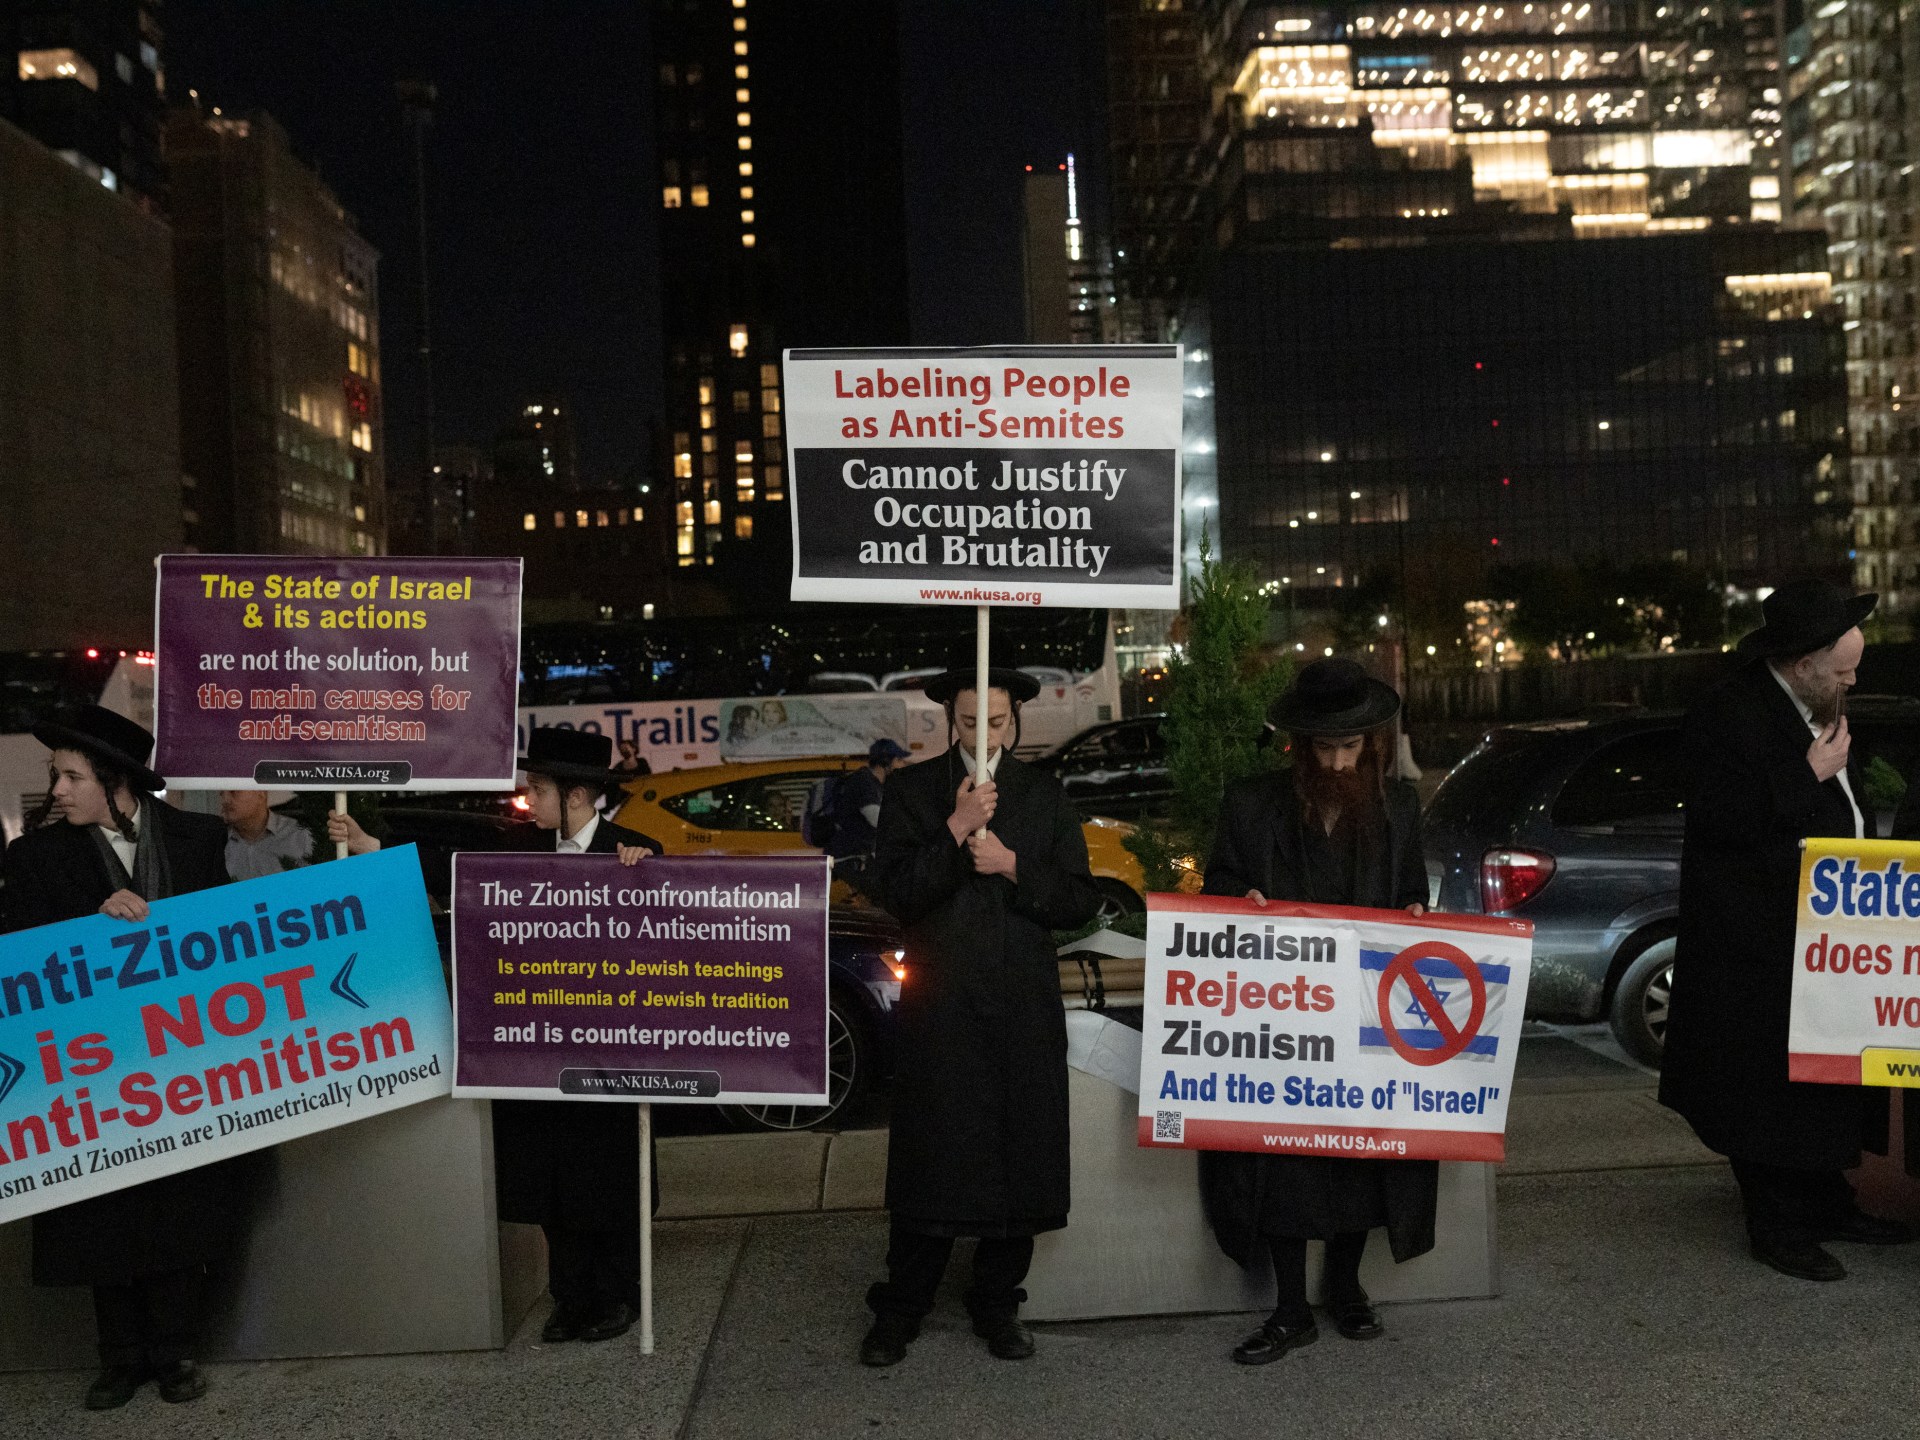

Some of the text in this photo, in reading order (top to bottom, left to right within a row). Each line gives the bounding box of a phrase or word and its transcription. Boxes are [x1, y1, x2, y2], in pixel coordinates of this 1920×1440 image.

[835, 367, 1130, 405] Labeling People
[841, 408, 1124, 439] as Anti-Semites
[842, 459, 1127, 500] Cannot Justify
[874, 497, 1092, 536] Occupation
[859, 534, 1111, 577] and Brutality
[201, 575, 471, 600] The State of Israel
[920, 587, 1041, 605] www.nkusa.org
[243, 603, 427, 629] & its actions
[200, 647, 469, 676] are not the solution, but
[198, 684, 471, 710] the main causes for
[239, 715, 425, 741] anti-semitism
[276, 767, 390, 782] www.NKUSA.org
[479, 881, 800, 909] The Zionist confrontational
[1810, 858, 1920, 917] State
[488, 914, 791, 944] approach to Antisemitism
[1166, 922, 1336, 963] Judaism
[0, 894, 367, 1019] nti-Zionism
[1804, 933, 1892, 975] does
[498, 958, 783, 982] Is contrary to Jewish teachings
[493, 989, 789, 1009] and millennia of Jewish tradition
[1165, 970, 1335, 1016] Rejects
[35, 964, 315, 1085] is NOT
[493, 1022, 790, 1049] and is counterproductive
[1161, 1020, 1335, 1063] Zionism
[582, 1075, 698, 1093] www.NKUSA.org
[1160, 1070, 1500, 1115] And the State of "Israel"
[41, 1153, 83, 1186] and
[87, 1132, 178, 1174] Zionism
[181, 1123, 214, 1146] are
[217, 1082, 354, 1137] Diametrically
[357, 1054, 441, 1099] Opposed
[1263, 1133, 1406, 1154] www.NKUSA.org
